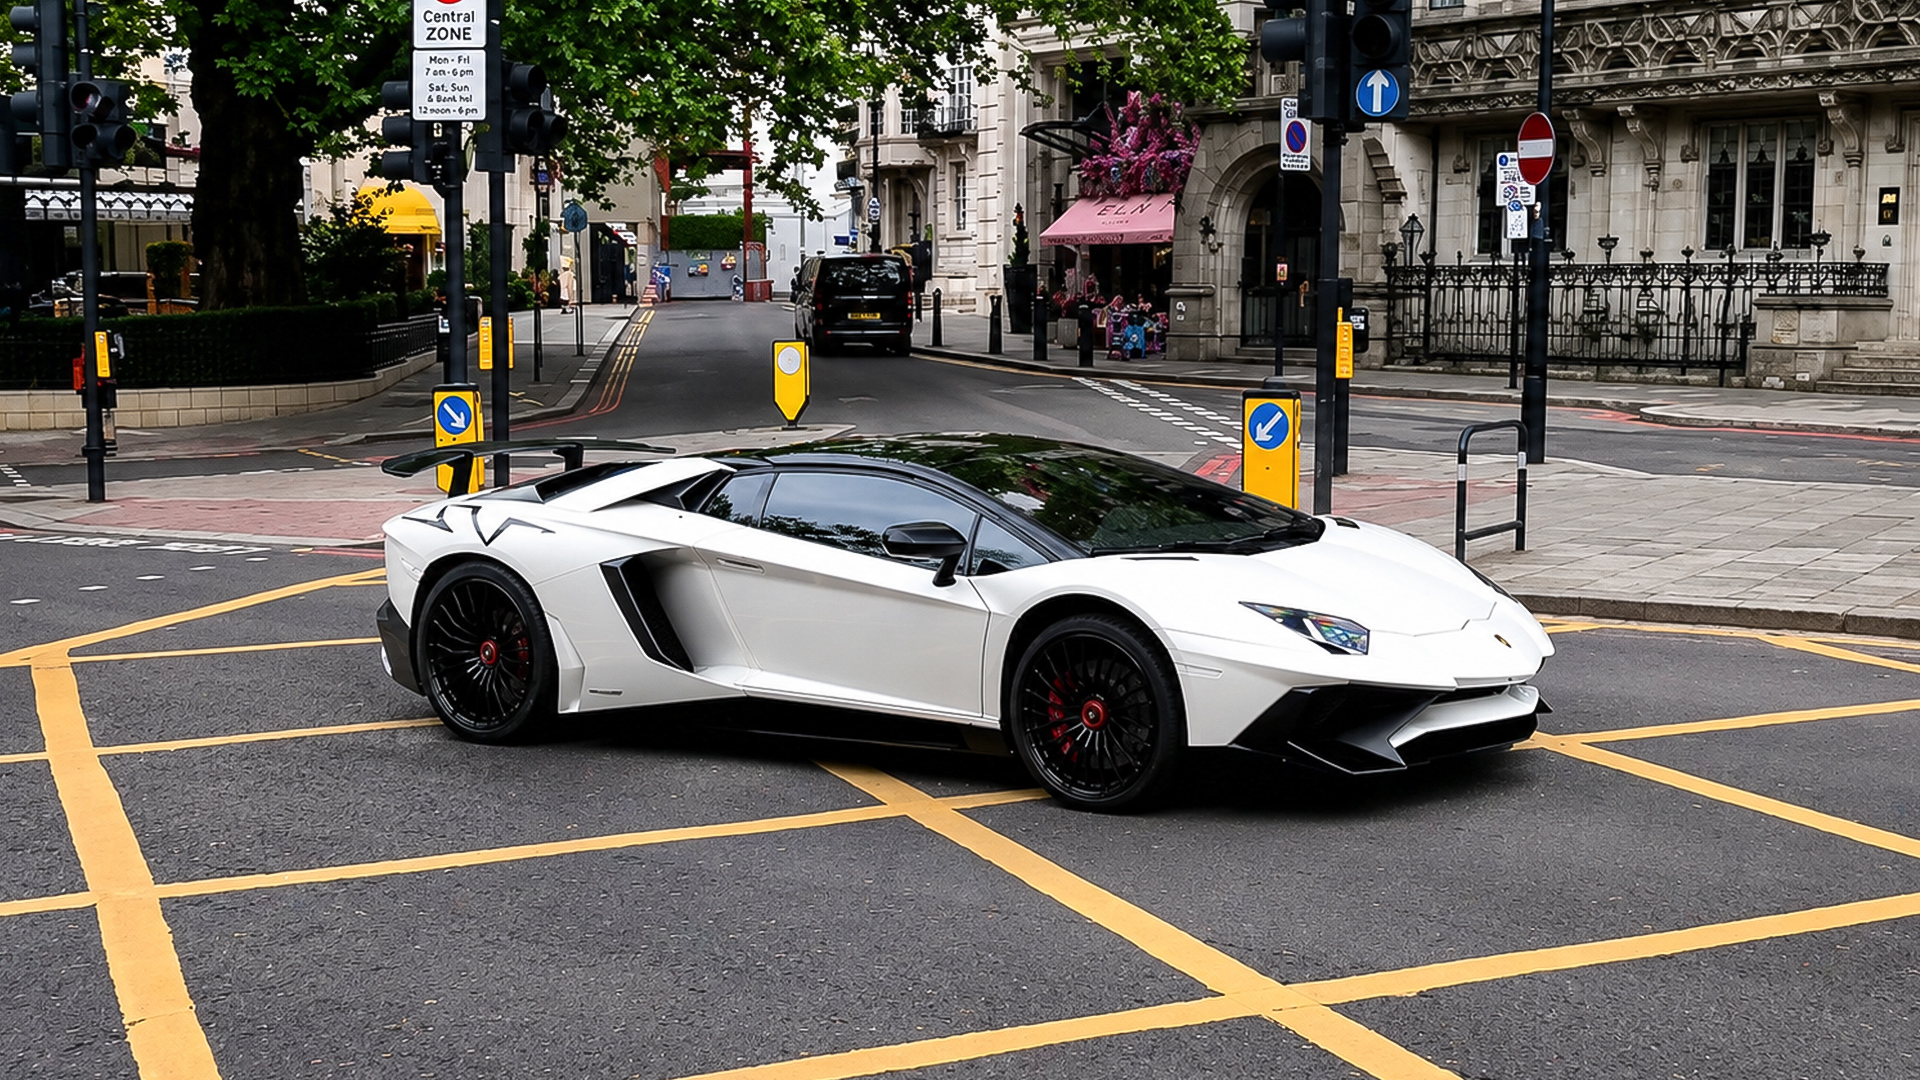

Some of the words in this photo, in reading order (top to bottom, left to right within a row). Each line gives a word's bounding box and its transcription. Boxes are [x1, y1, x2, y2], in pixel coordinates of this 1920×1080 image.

[423, 10, 475, 23] Central
[426, 27, 472, 41] ZONE
[429, 55, 449, 64] Mon
[451, 82, 470, 92] Sun
